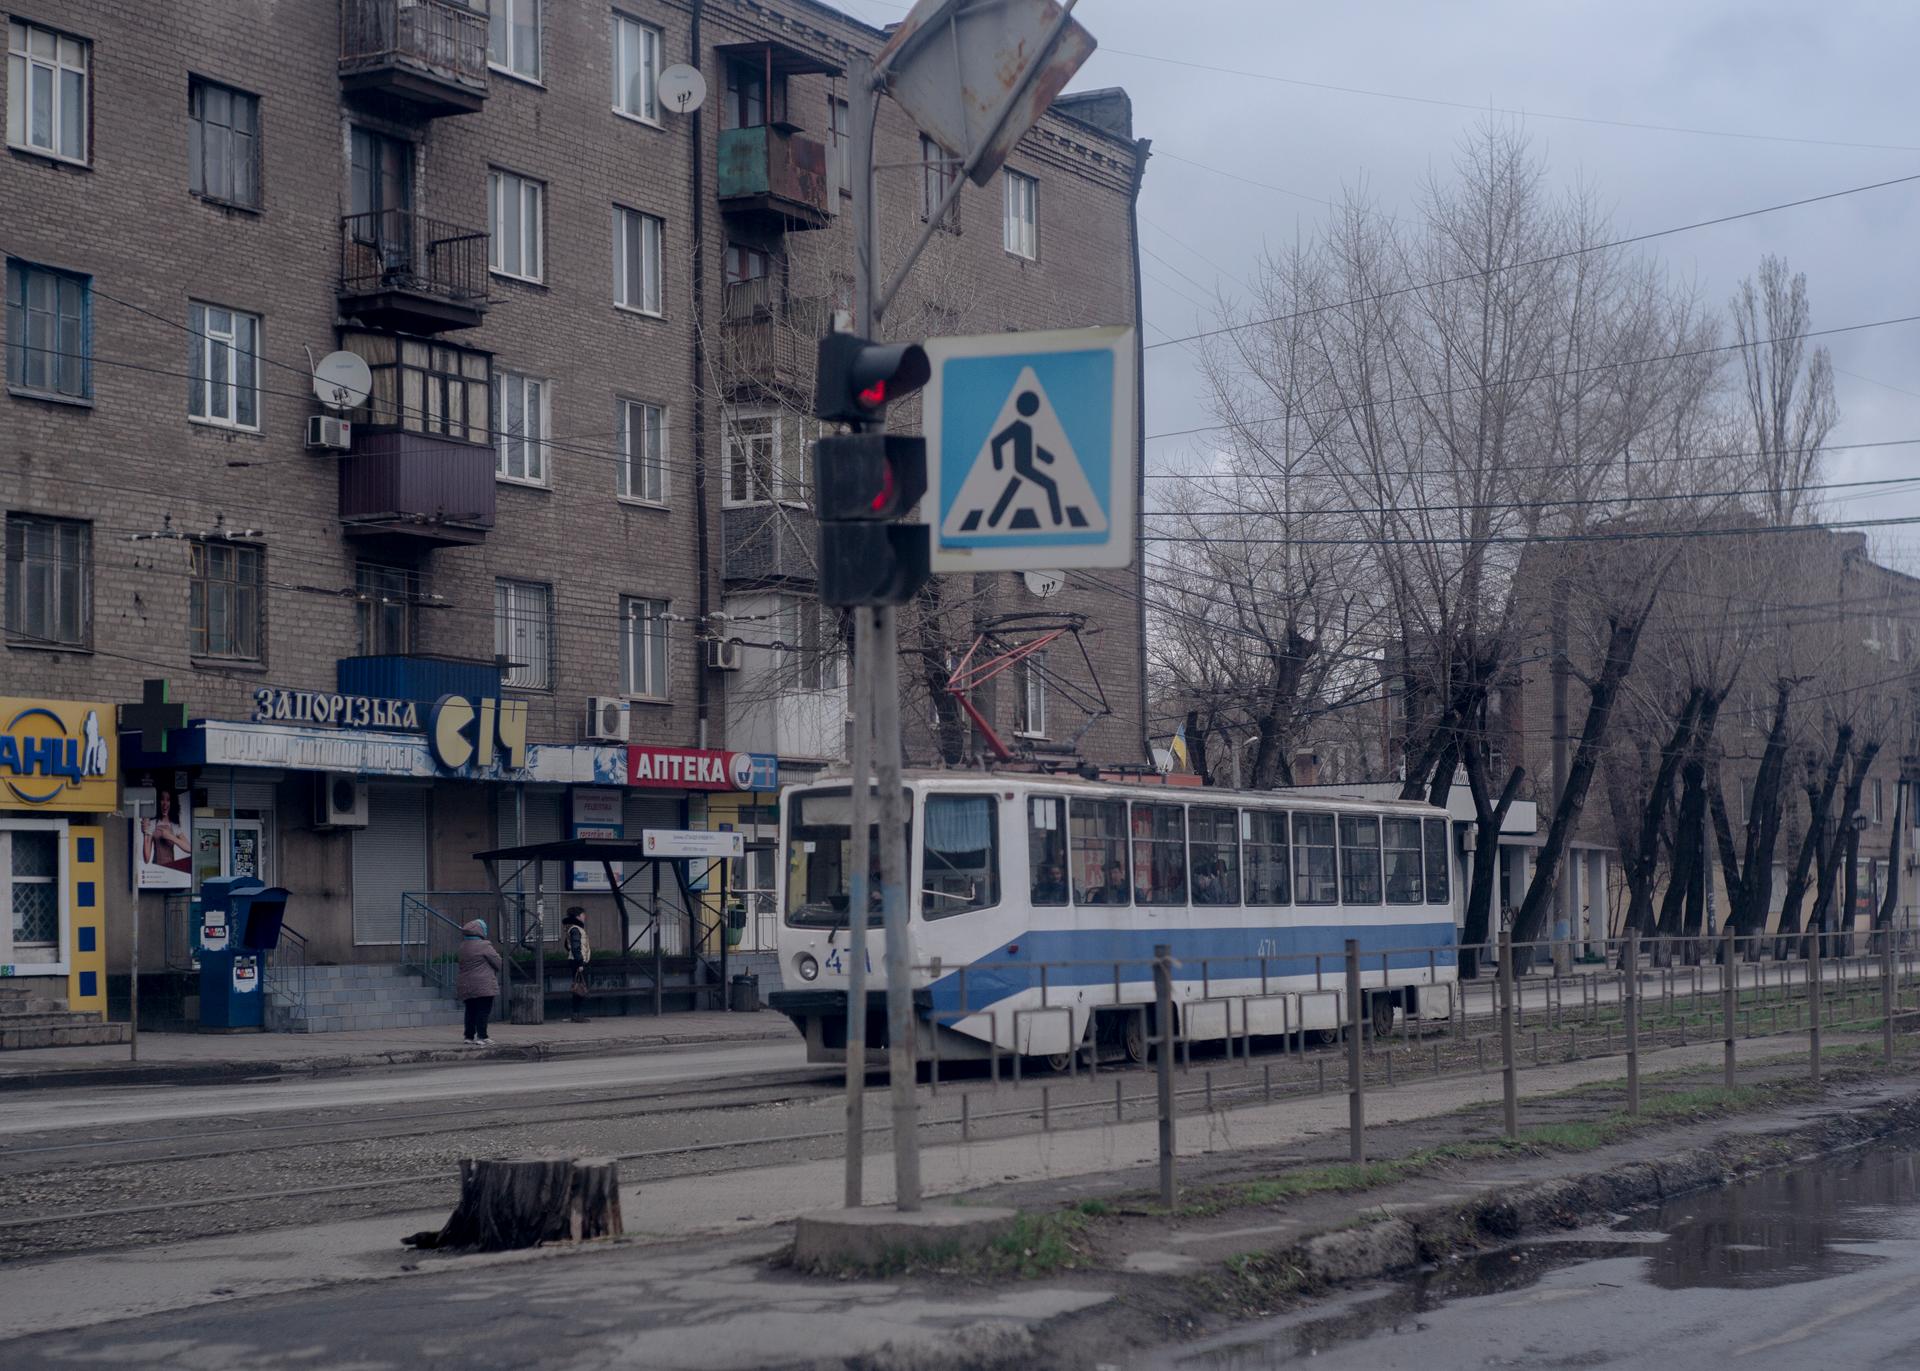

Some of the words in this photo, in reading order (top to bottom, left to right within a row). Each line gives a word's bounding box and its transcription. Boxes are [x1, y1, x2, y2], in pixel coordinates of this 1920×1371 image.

[256, 688, 420, 728] ЗАПОРІЗЬКА
[433, 694, 528, 769] СІЧ
[367, 744, 414, 774] ВИРОБИ
[636, 752, 726, 784] АПТЕКА
[1257, 938, 1277, 958] 471
